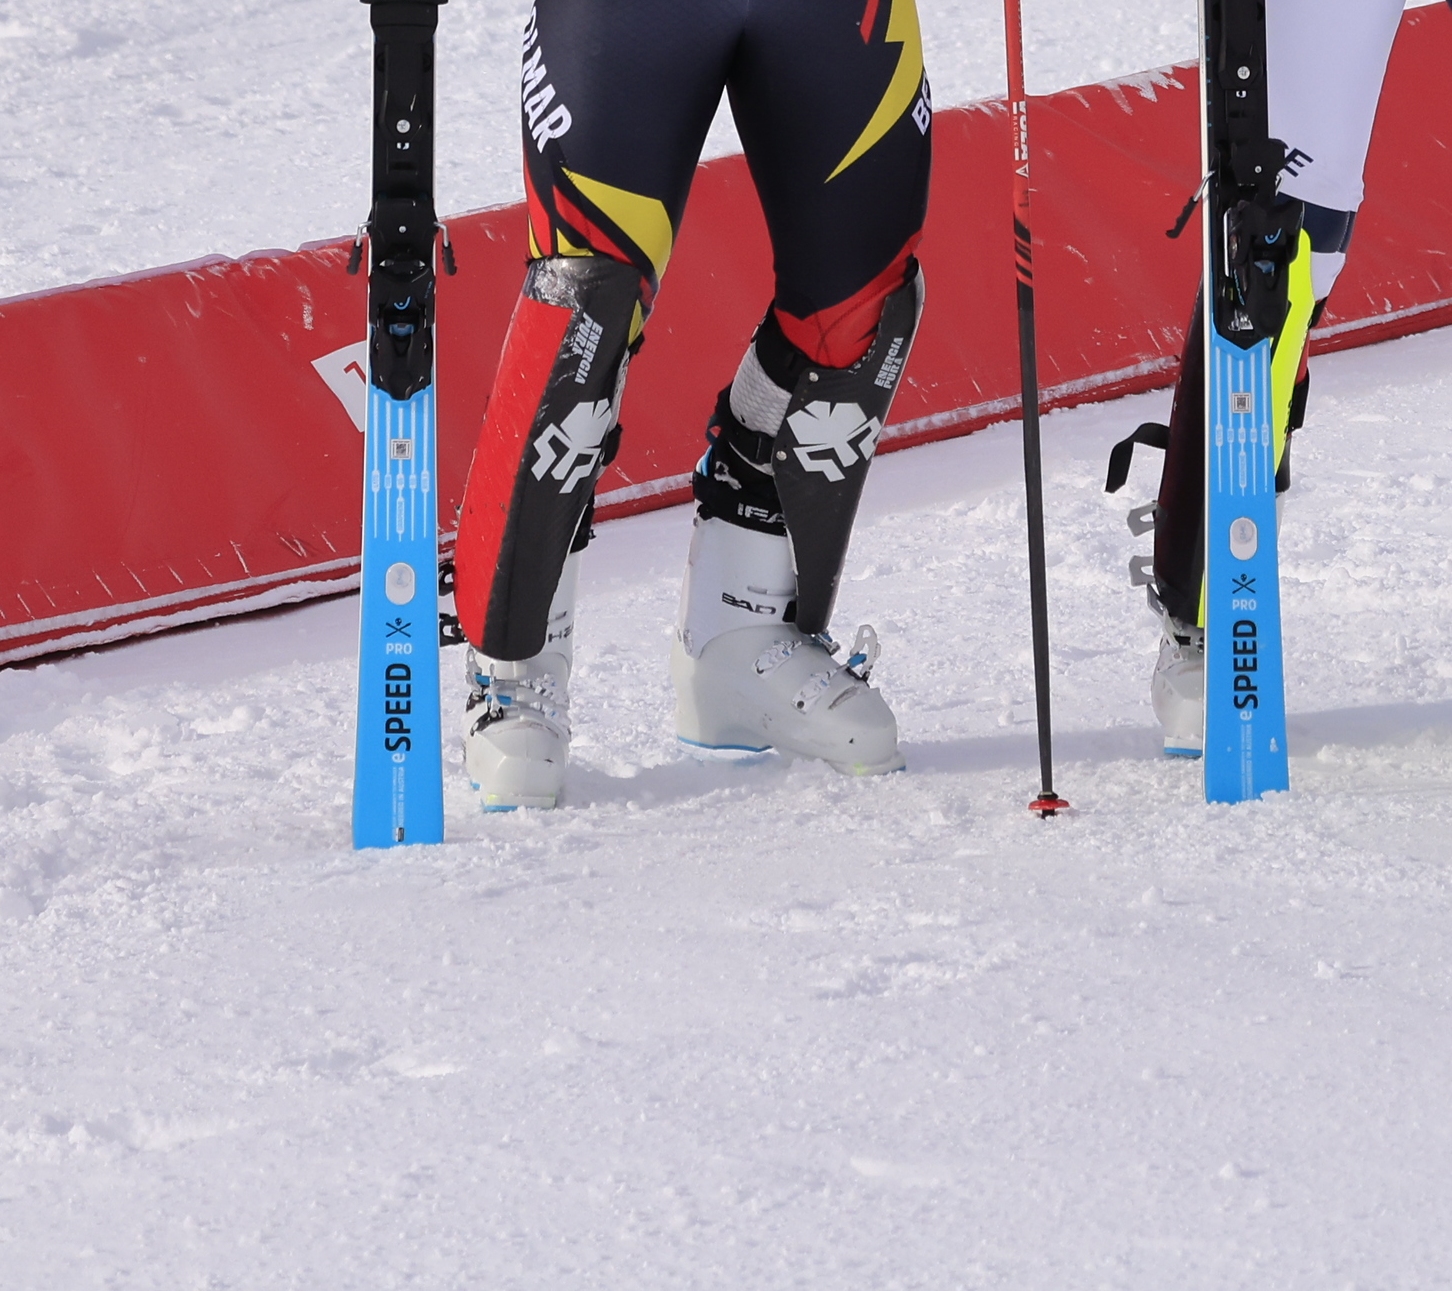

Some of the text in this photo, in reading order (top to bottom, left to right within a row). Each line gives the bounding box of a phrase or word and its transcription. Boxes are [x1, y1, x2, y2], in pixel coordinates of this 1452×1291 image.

[575, 318, 604, 385] ENERGIA
[874, 336, 904, 388] ENERGIA
[721, 591, 777, 616] EAD
[1232, 597, 1258, 611] PRO
[386, 642, 413, 655] PRO
[1233, 619, 1259, 711] SPEED
[384, 663, 412, 752] SPEED
